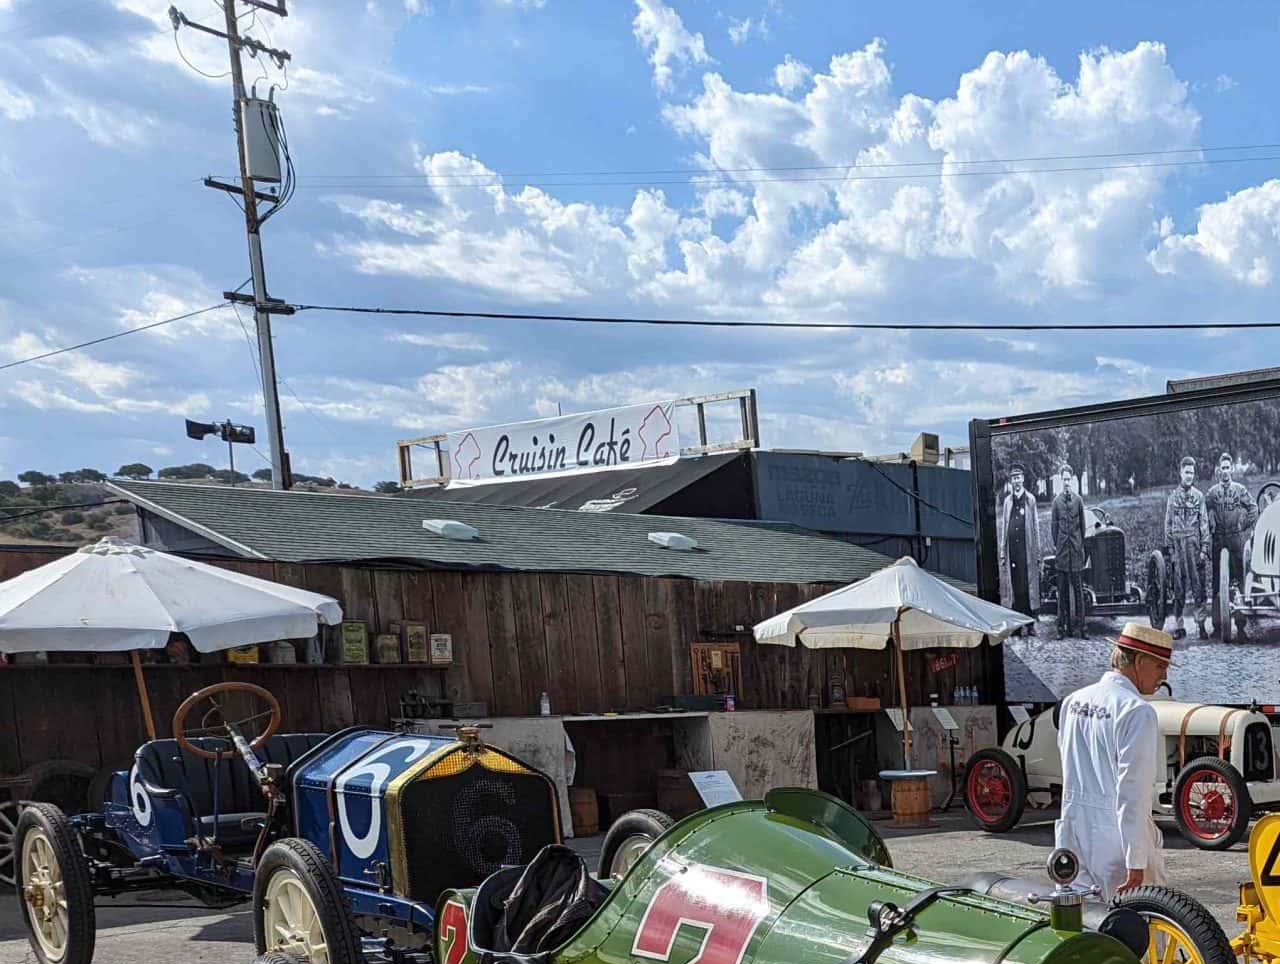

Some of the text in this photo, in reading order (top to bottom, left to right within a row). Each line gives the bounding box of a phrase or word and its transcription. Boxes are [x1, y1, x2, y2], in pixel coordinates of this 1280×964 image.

[492, 417, 631, 476] Cruisin Café
[1247, 731, 1269, 772] 13
[129, 762, 153, 827] 6
[335, 739, 432, 860] 6
[450, 778, 523, 876] 6
